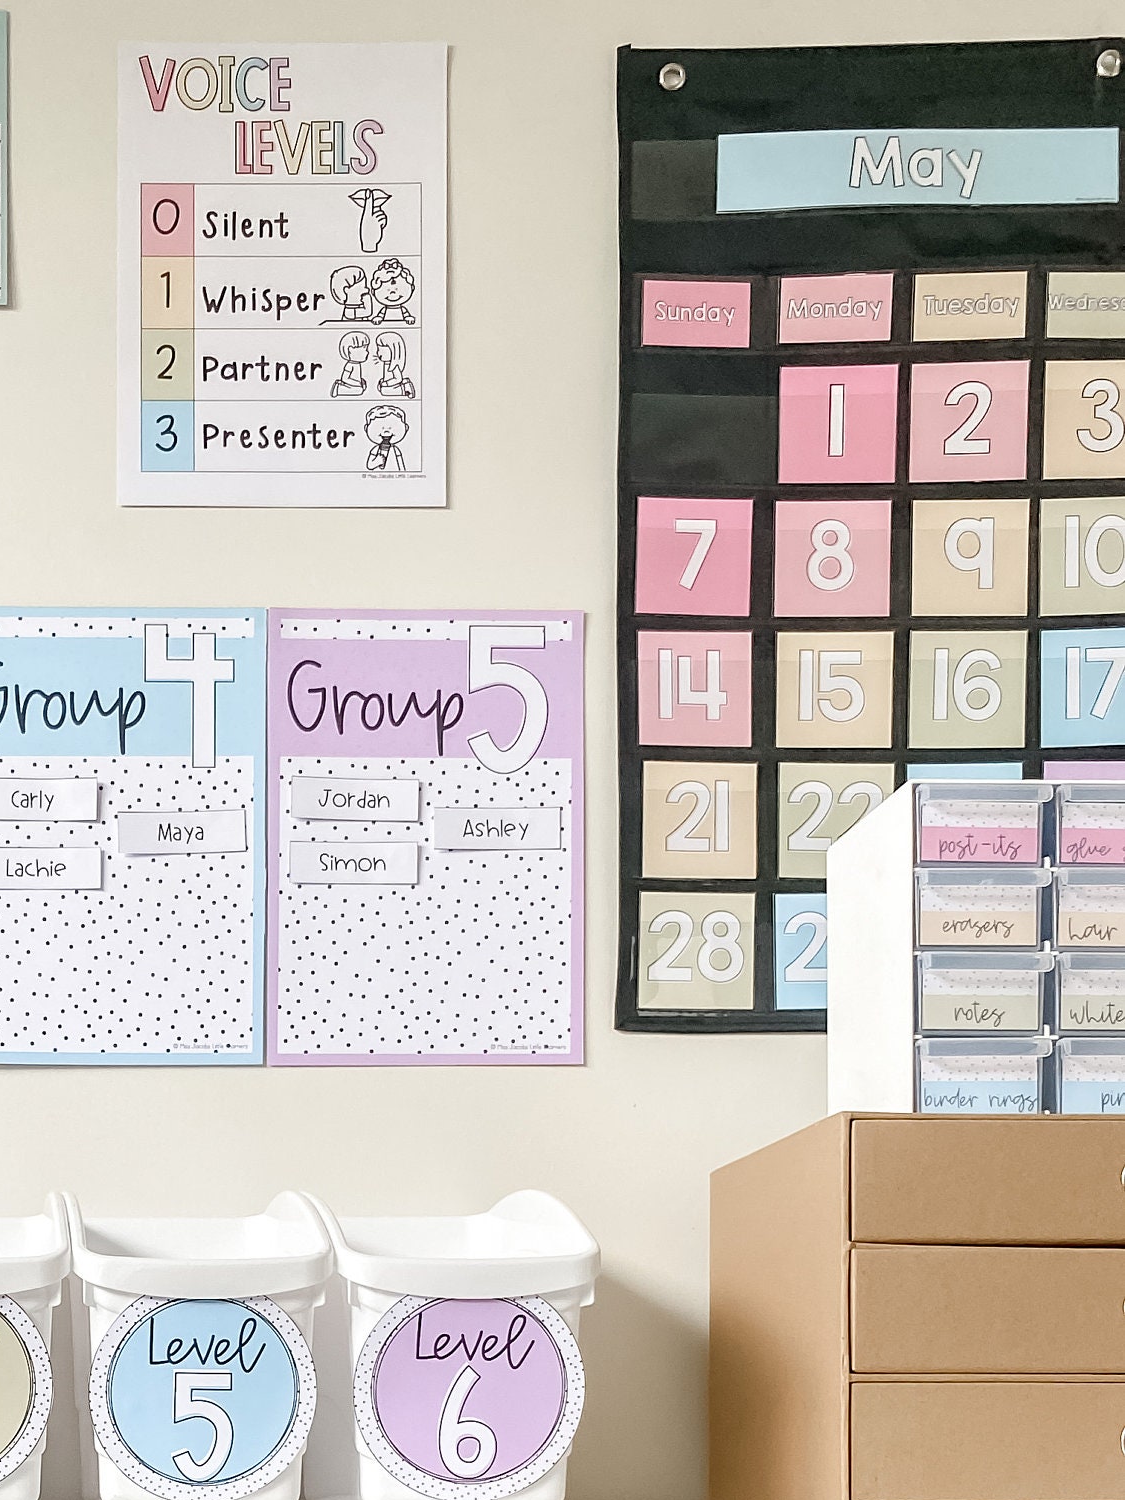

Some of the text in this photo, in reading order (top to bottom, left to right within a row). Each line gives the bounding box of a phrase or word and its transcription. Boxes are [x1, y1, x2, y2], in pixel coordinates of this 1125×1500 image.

[139, 55, 292, 113] VOICE
[235, 119, 384, 175] LEVELS
[848, 136, 983, 199] May
[152, 198, 290, 239] 0 Silent
[160, 271, 326, 320] 1 Whisper
[654, 301, 735, 327] Sunday
[786, 297, 883, 321] Monday
[923, 293, 1020, 317] Tuesday
[156, 344, 323, 382] 2 Partner
[155, 414, 356, 452] 3 Presenter
[827, 378, 1125, 457] 1 2 3
[674, 514, 1125, 591] 7 8 9 10
[144, 624, 235, 769] 4
[287, 625, 549, 775] Group 5
[657, 646, 1125, 722] 14 15 16 17
[10, 790, 55, 813] Carly
[318, 788, 391, 810] Jordan
[665, 779, 730, 852] 21
[157, 823, 205, 845] Maya
[463, 819, 530, 839] Ashley
[1066, 837, 1111, 862] glue
[5, 859, 67, 878] Lachie
[319, 853, 387, 873] Simon
[646, 909, 745, 983] 28
[942, 917, 1014, 938] erasers
[1068, 917, 1118, 941] hair
[954, 1002, 1006, 1027] notes
[923, 1088, 1038, 1114] binder rings
[148, 1316, 267, 1374] Level
[415, 1312, 535, 1370] Level
[171, 1371, 235, 1482] 5
[438, 1364, 498, 1480] 6
